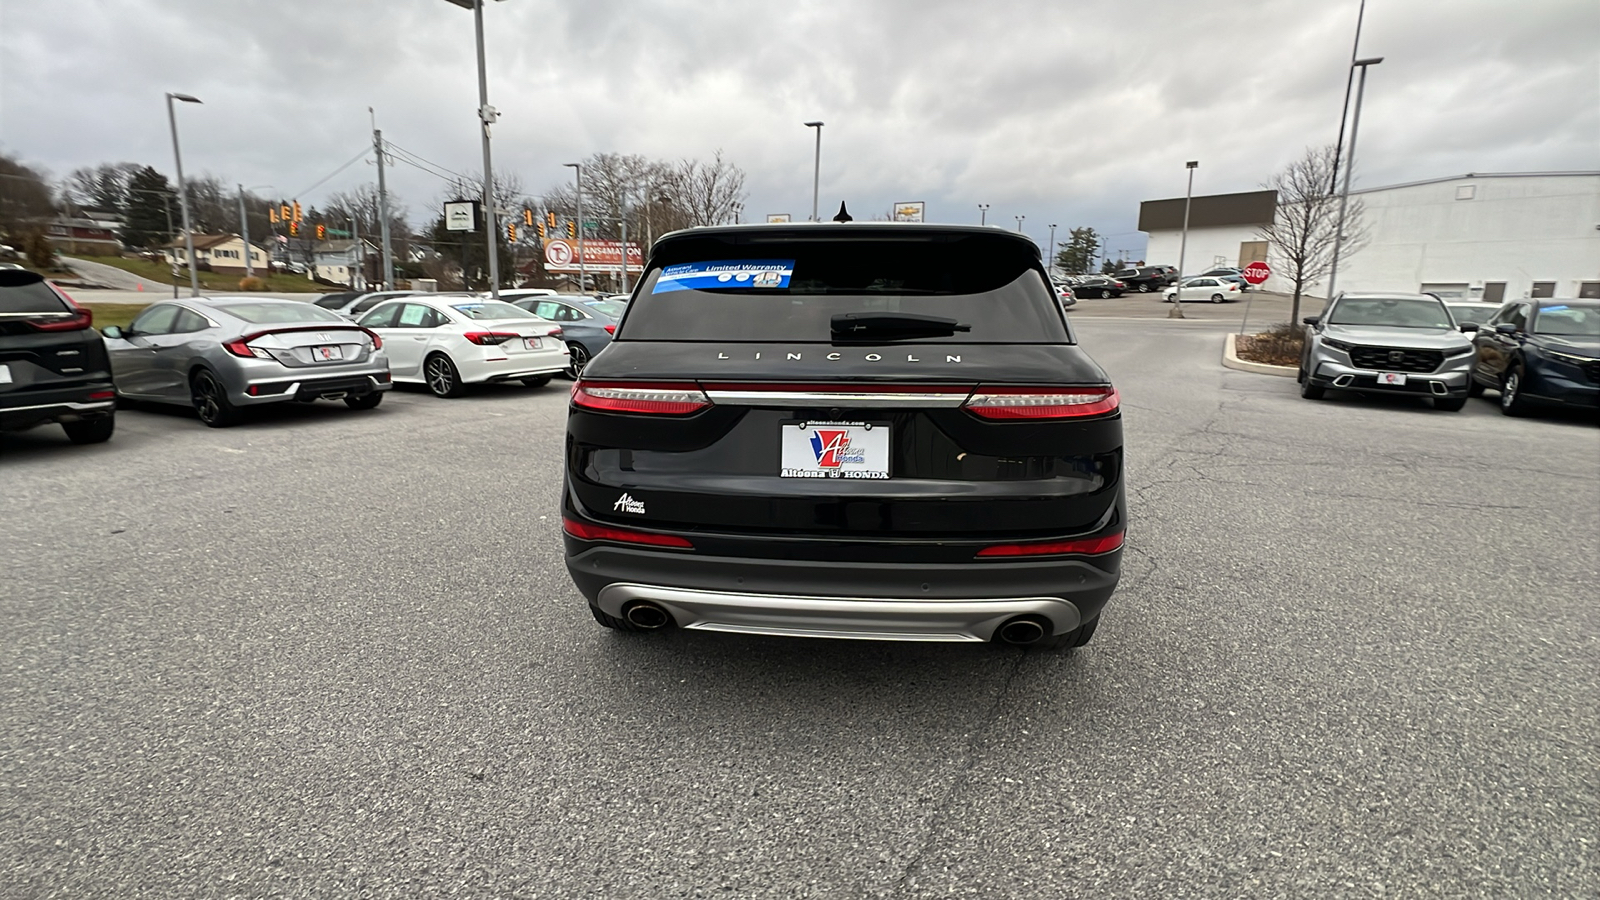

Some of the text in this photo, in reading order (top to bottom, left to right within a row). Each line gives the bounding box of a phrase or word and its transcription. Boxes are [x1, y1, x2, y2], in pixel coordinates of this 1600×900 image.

[1244, 268, 1270, 278] STOP
[718, 352, 962, 363] LINCOLN
[837, 455, 865, 463] Honda
[780, 468, 825, 478] Altoona
[844, 471, 889, 479] HONDA
[626, 506, 646, 514] Honda
